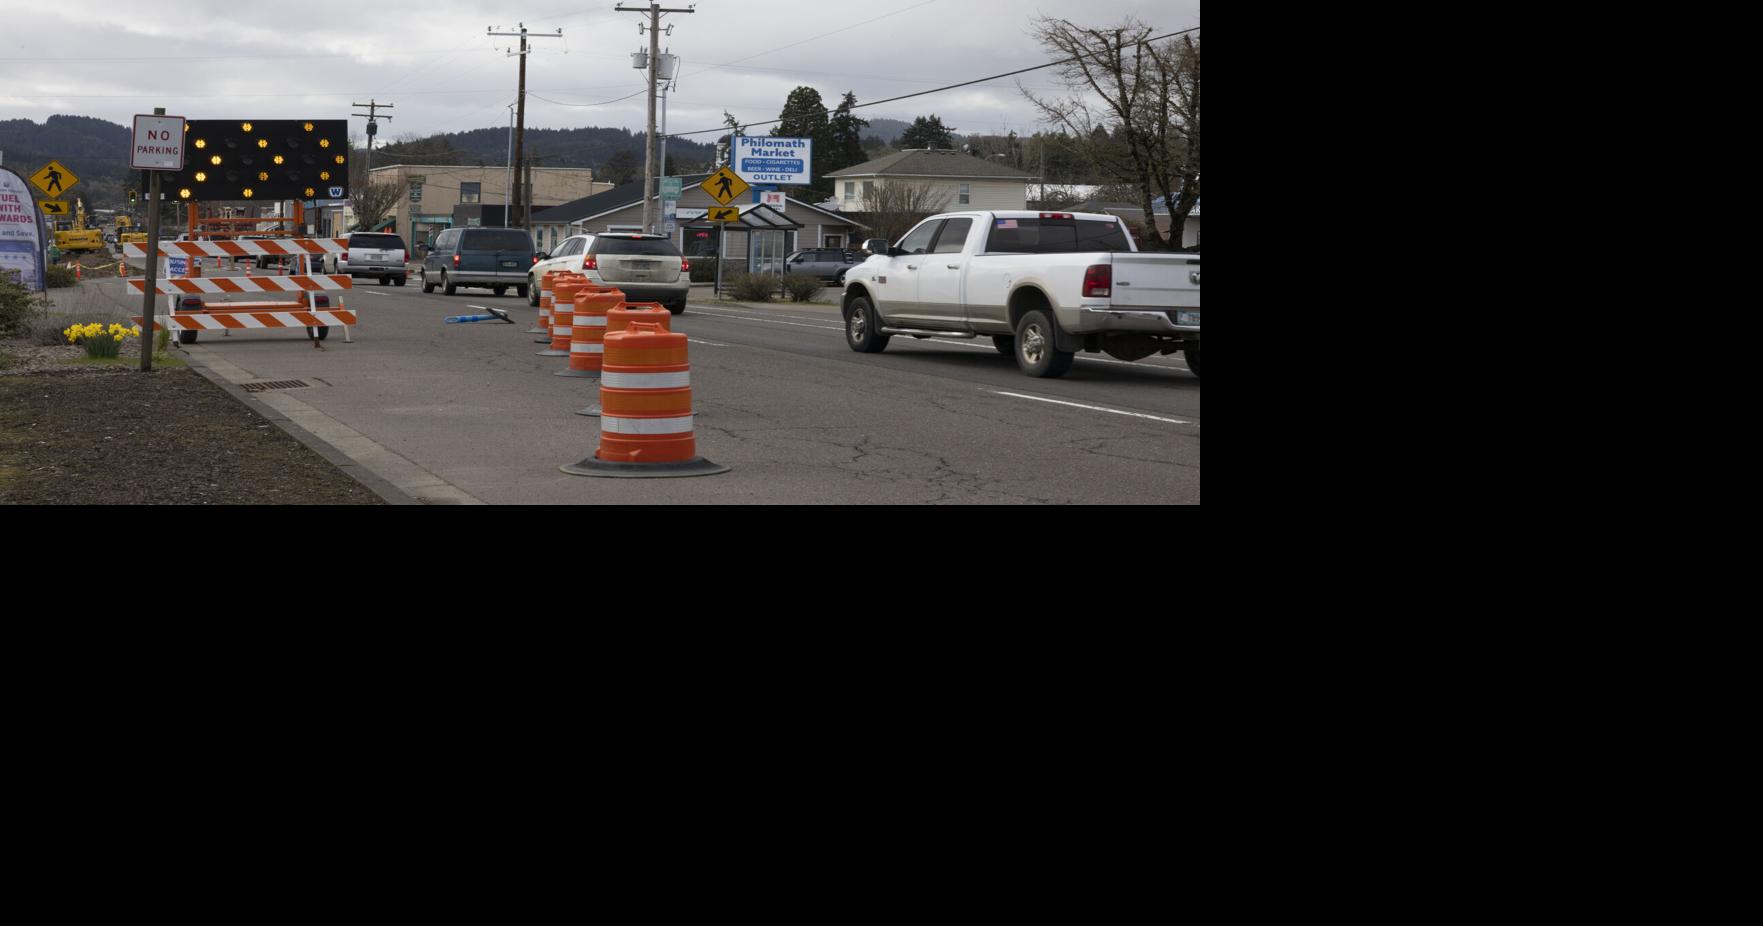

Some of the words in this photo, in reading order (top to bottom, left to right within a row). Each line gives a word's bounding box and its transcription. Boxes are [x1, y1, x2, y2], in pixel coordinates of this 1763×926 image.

[147, 130, 170, 141] NO
[741, 138, 805, 148] Philomath
[137, 145, 179, 155] PARKING
[751, 148, 796, 157] Market
[0, 193, 20, 203] UEL
